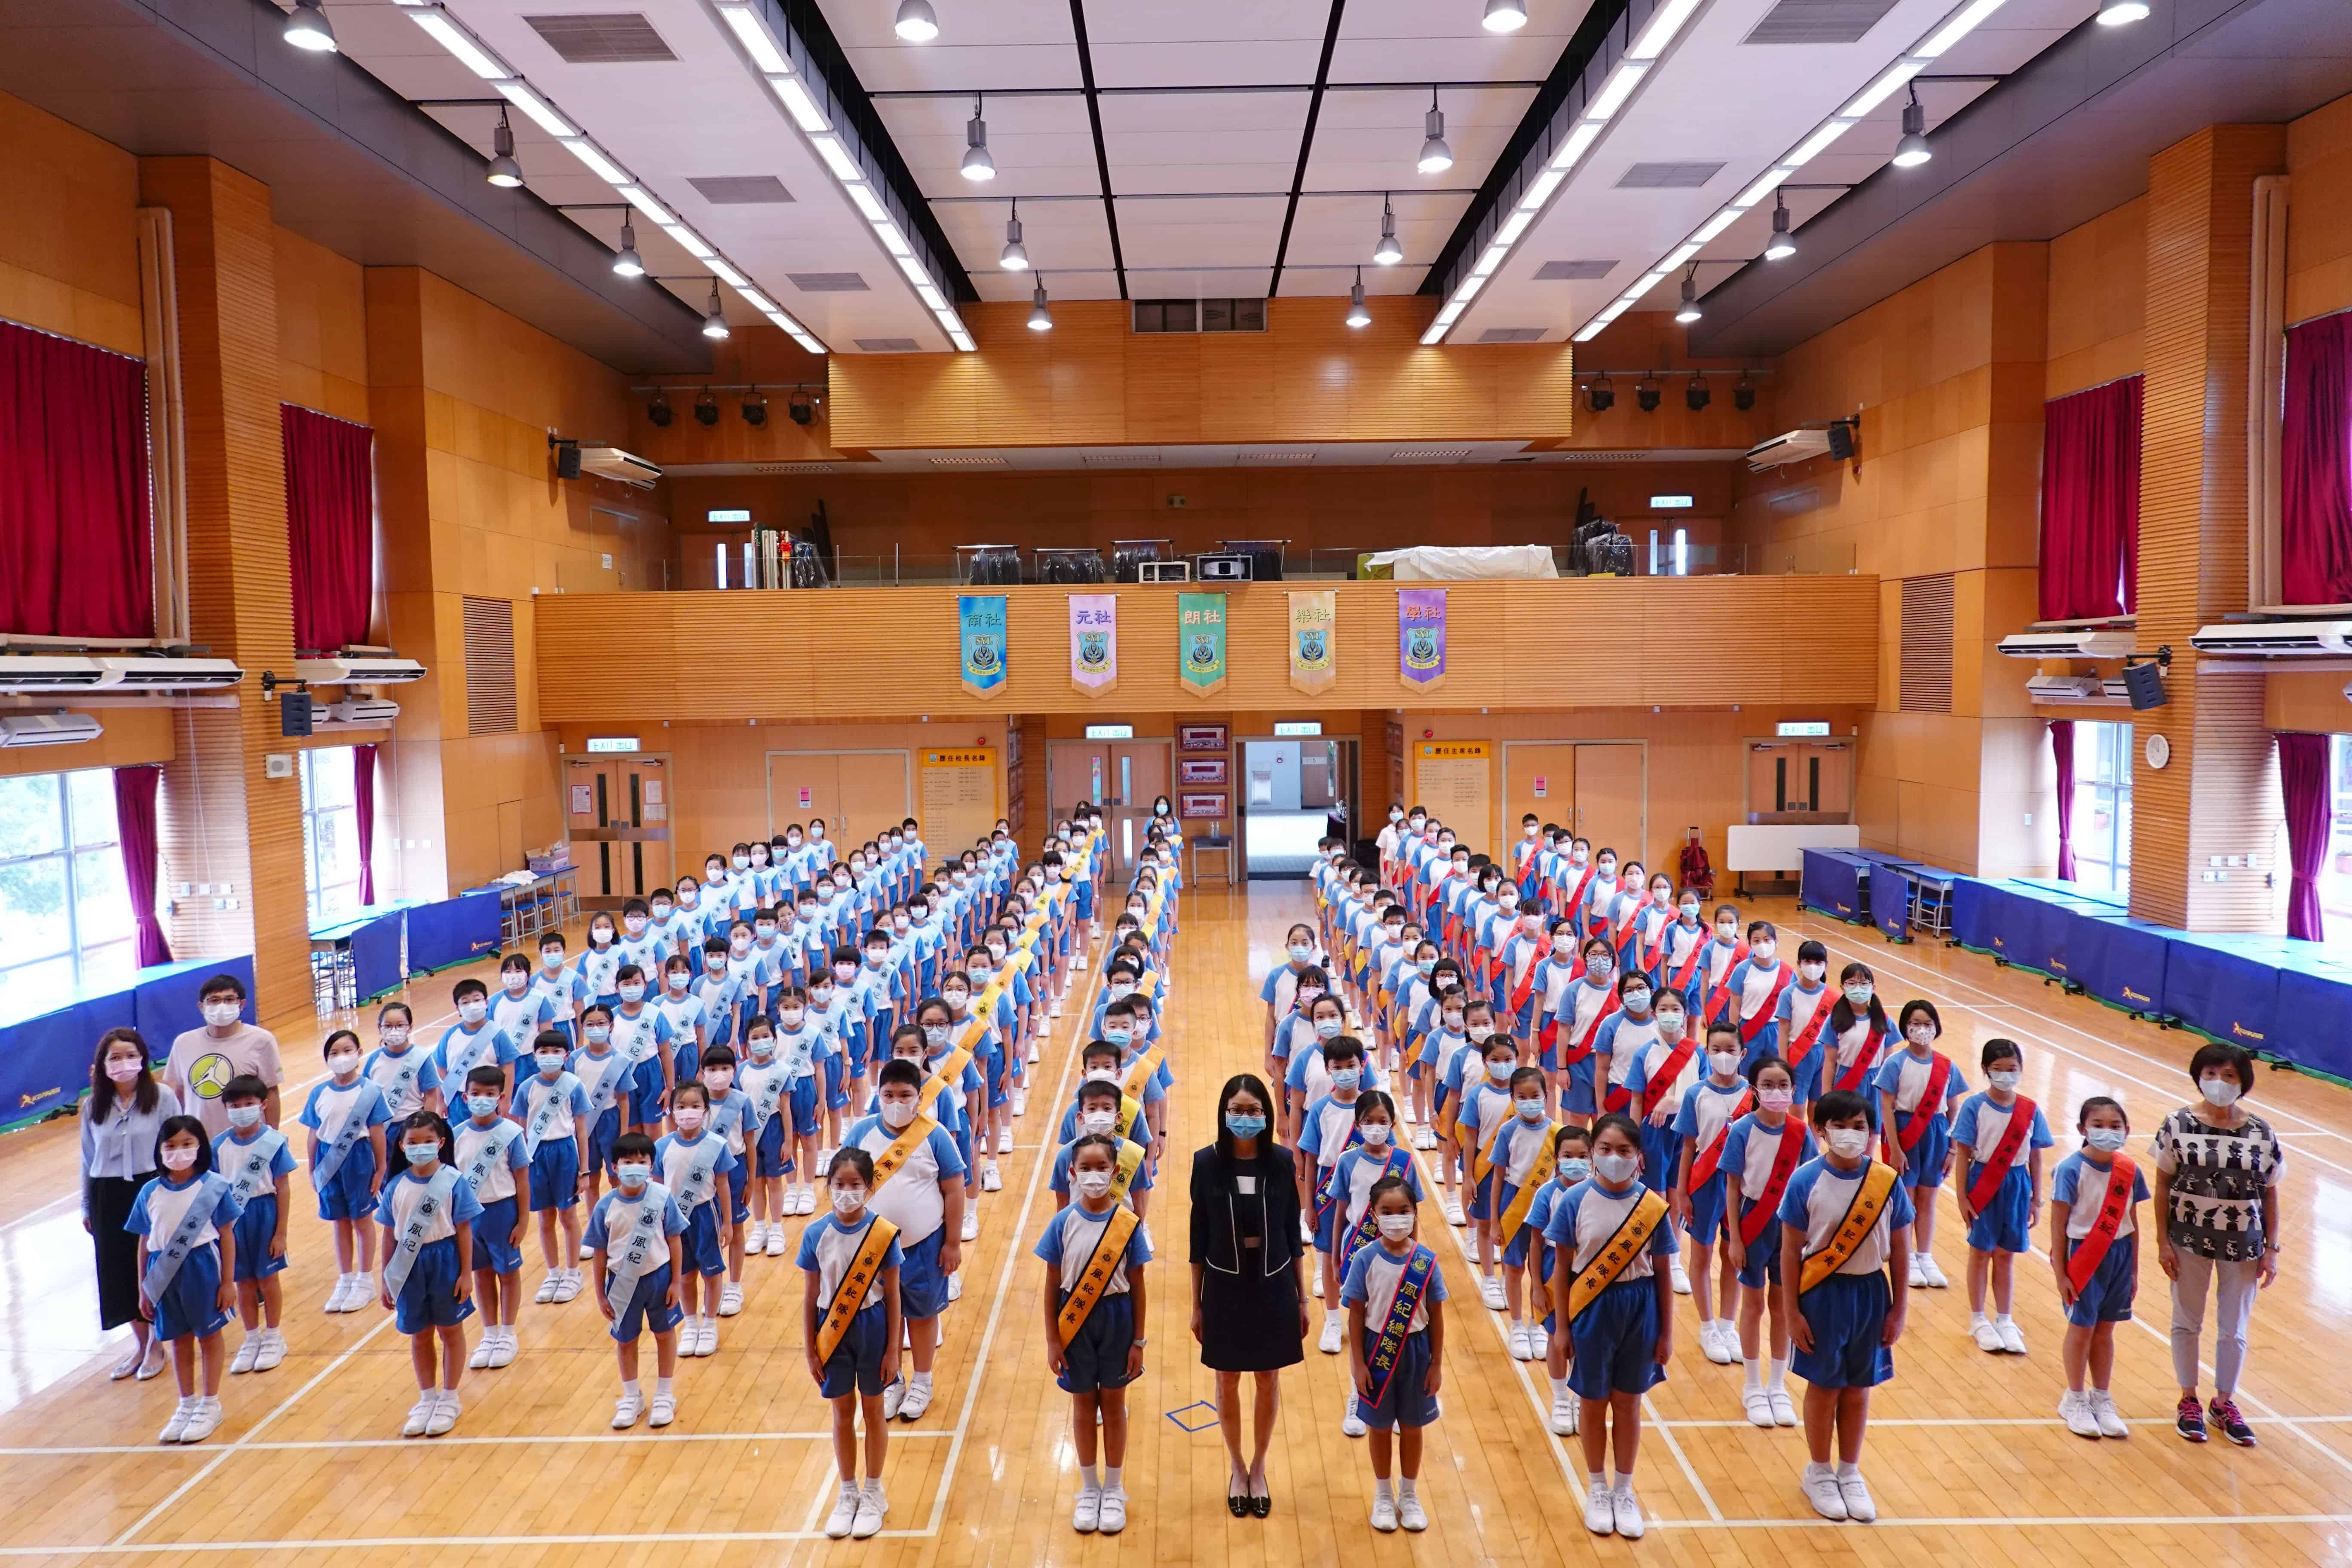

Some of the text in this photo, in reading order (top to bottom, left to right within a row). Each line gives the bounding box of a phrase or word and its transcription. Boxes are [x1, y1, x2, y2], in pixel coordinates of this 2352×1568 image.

[966, 613, 1002, 628] 南社
[1076, 609, 1112, 625] 元社
[1185, 609, 1221, 625] 朗社
[1295, 608, 1331, 623] 樂社
[1406, 605, 1442, 621] 學社
[976, 637, 993, 645] SYL
[1086, 634, 1103, 643] SYL
[1195, 635, 1212, 644] SYL
[1304, 631, 1322, 640] SYL
[1415, 630, 1432, 639] SYL
[1784, 725, 1822, 734] EXIT 出口
[594, 741, 632, 750] EXIT 出口
[1805, 1020, 1821, 1041] 風紀
[629, 1036, 643, 1057] 風紀
[388, 1086, 402, 1108] 風紀
[756, 1099, 771, 1121] 風紀
[533, 1111, 549, 1135] 風紀
[468, 1163, 484, 1189] 風紀
[873, 1159, 894, 1181] 風紀
[1530, 1167, 1547, 1189] 風紀
[232, 1179, 250, 1206] 風紀
[2098, 1205, 2120, 1235] 風紀
[167, 1235, 188, 1259] 風紀
[402, 1223, 422, 1253] 風紀
[1824, 1213, 1867, 1267] 風紀隊長
[626, 1235, 646, 1265] 風紀
[1585, 1239, 1632, 1290] 風紀隊長
[830, 1272, 865, 1331] 風紀隊長
[1066, 1268, 1102, 1324] 風紀隊長
[1375, 1281, 1418, 1371] 風紀總隊長
